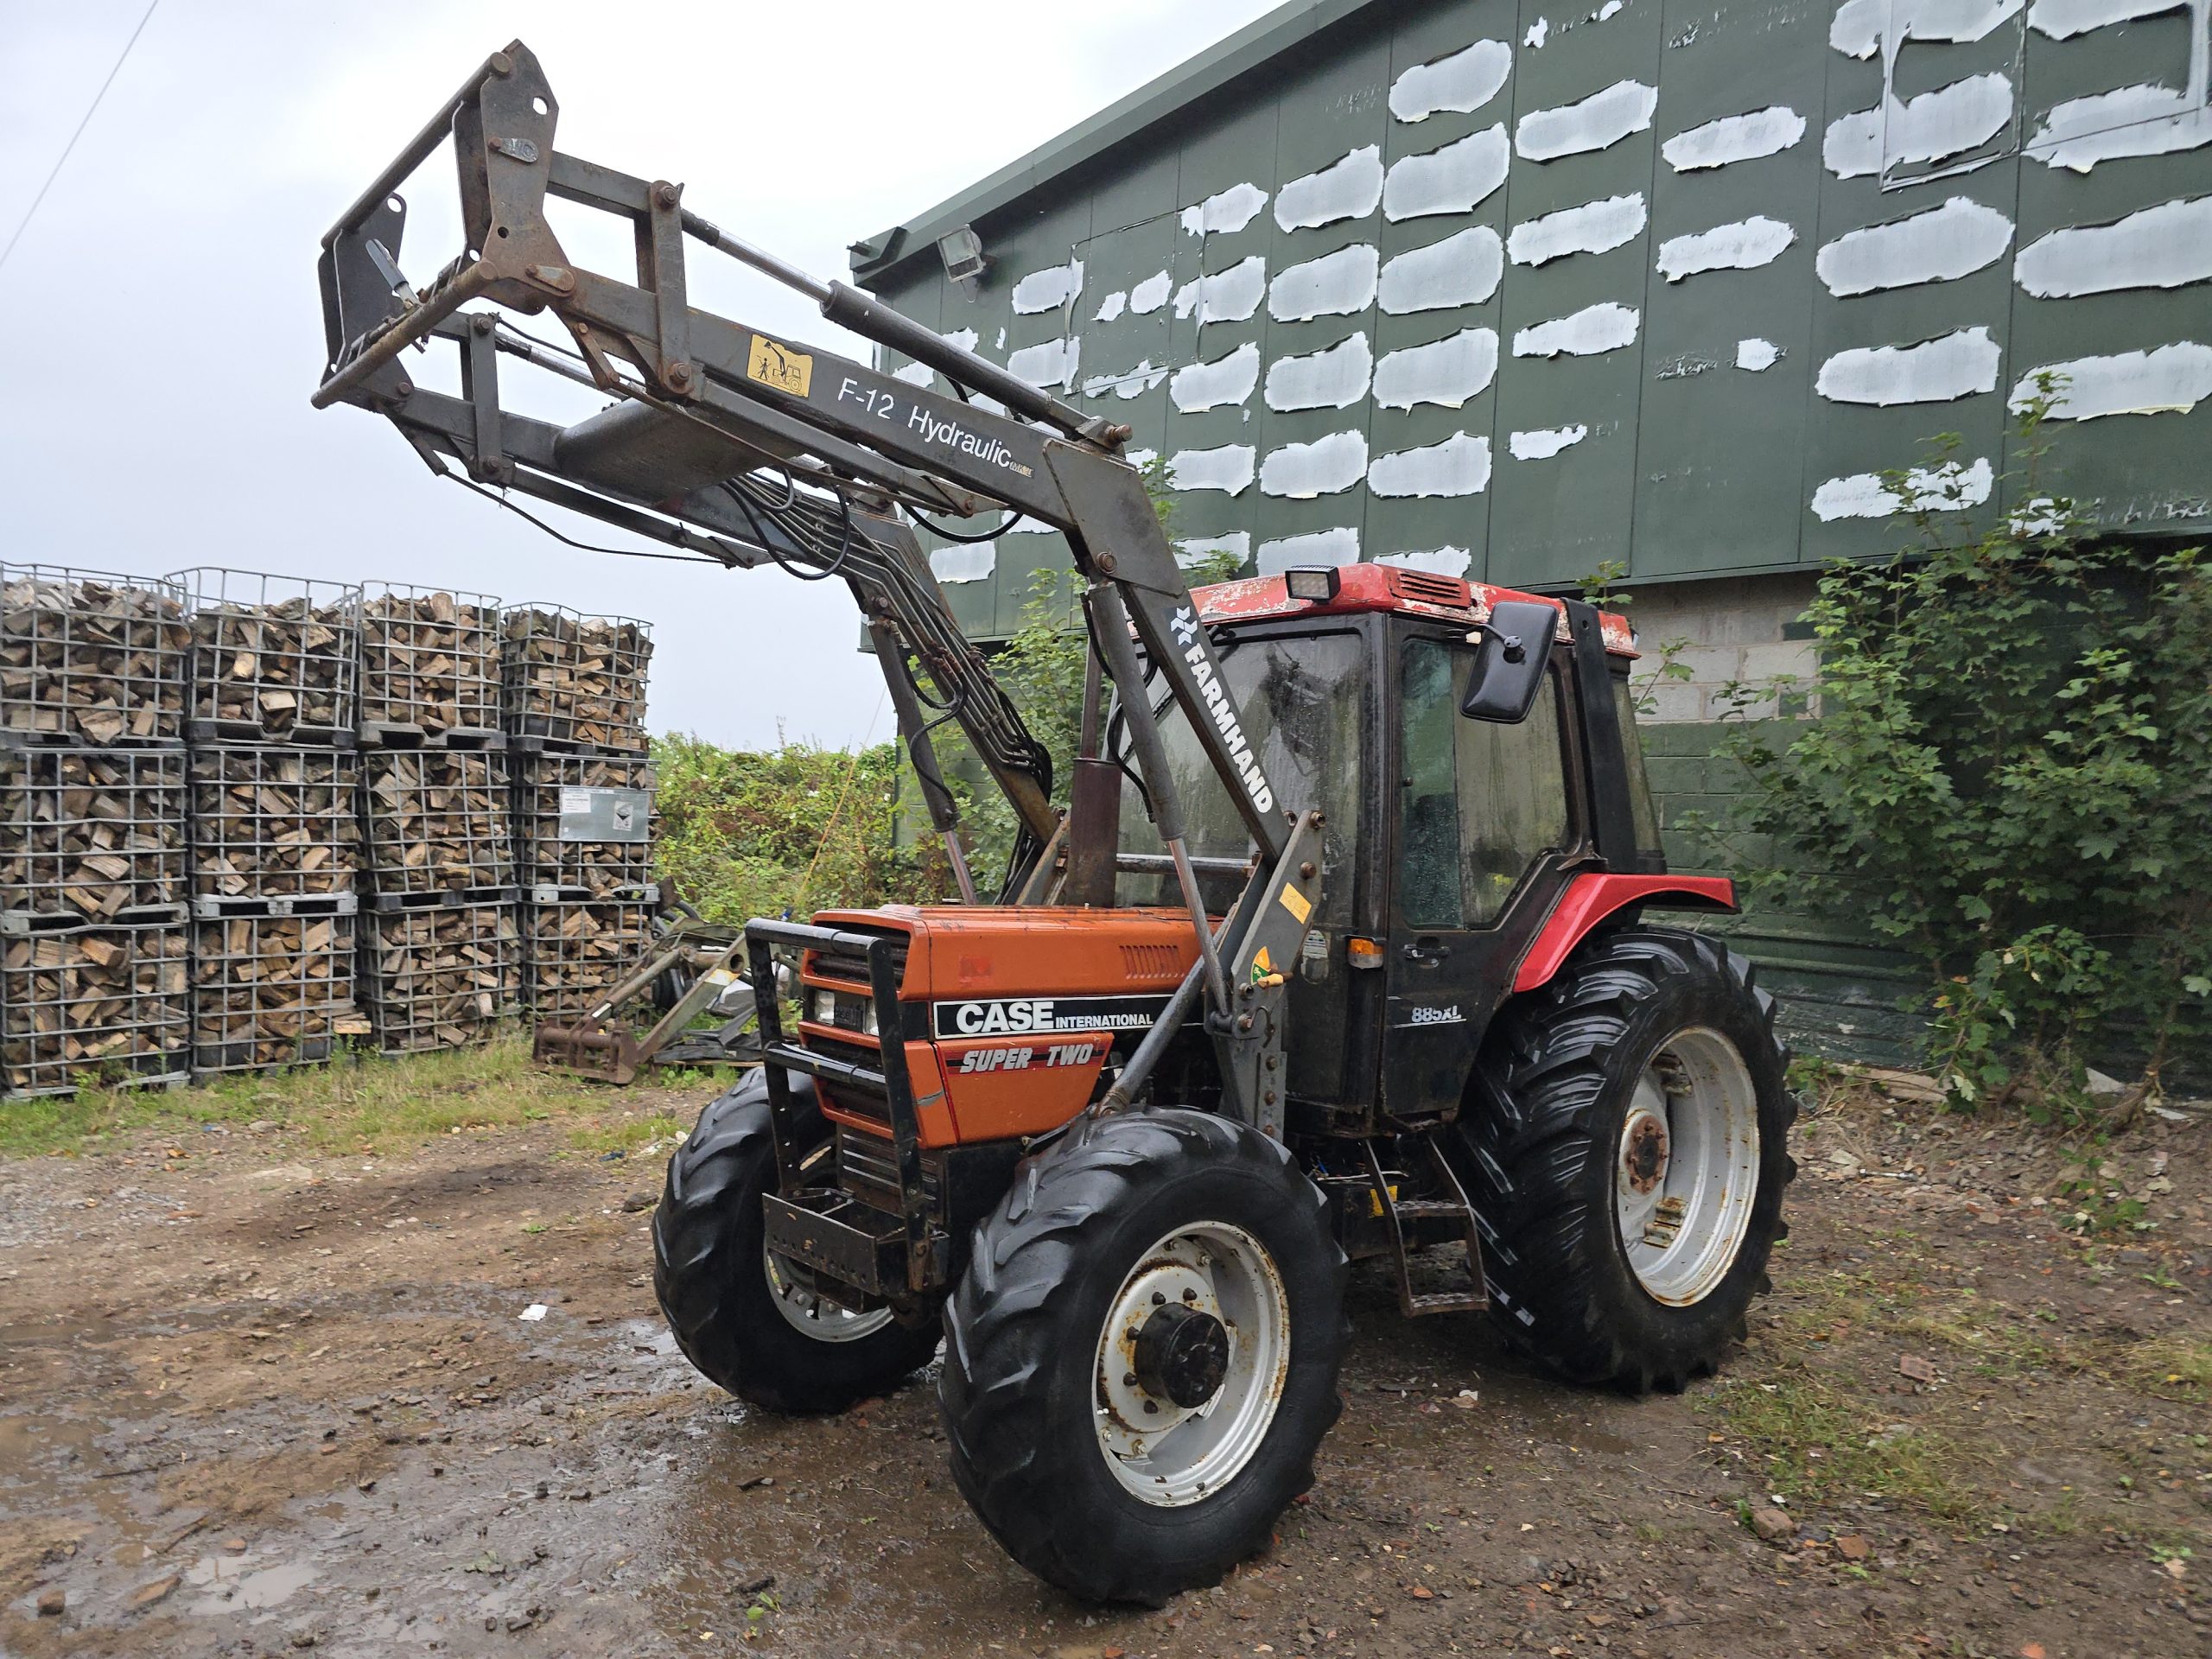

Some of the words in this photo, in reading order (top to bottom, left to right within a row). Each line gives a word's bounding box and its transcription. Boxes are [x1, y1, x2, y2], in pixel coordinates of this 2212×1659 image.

[837, 377, 894, 420] F-12
[907, 404, 1012, 467] Hydraulic
[1185, 642, 1274, 814] FARMHAND
[956, 1001, 1054, 1034] CASE
[1055, 1014, 1154, 1029] INTERNATIONAL
[1411, 1005, 1462, 1023] 885XL
[959, 1047, 1033, 1074] SUPER
[1046, 1043, 1094, 1067] TWO
